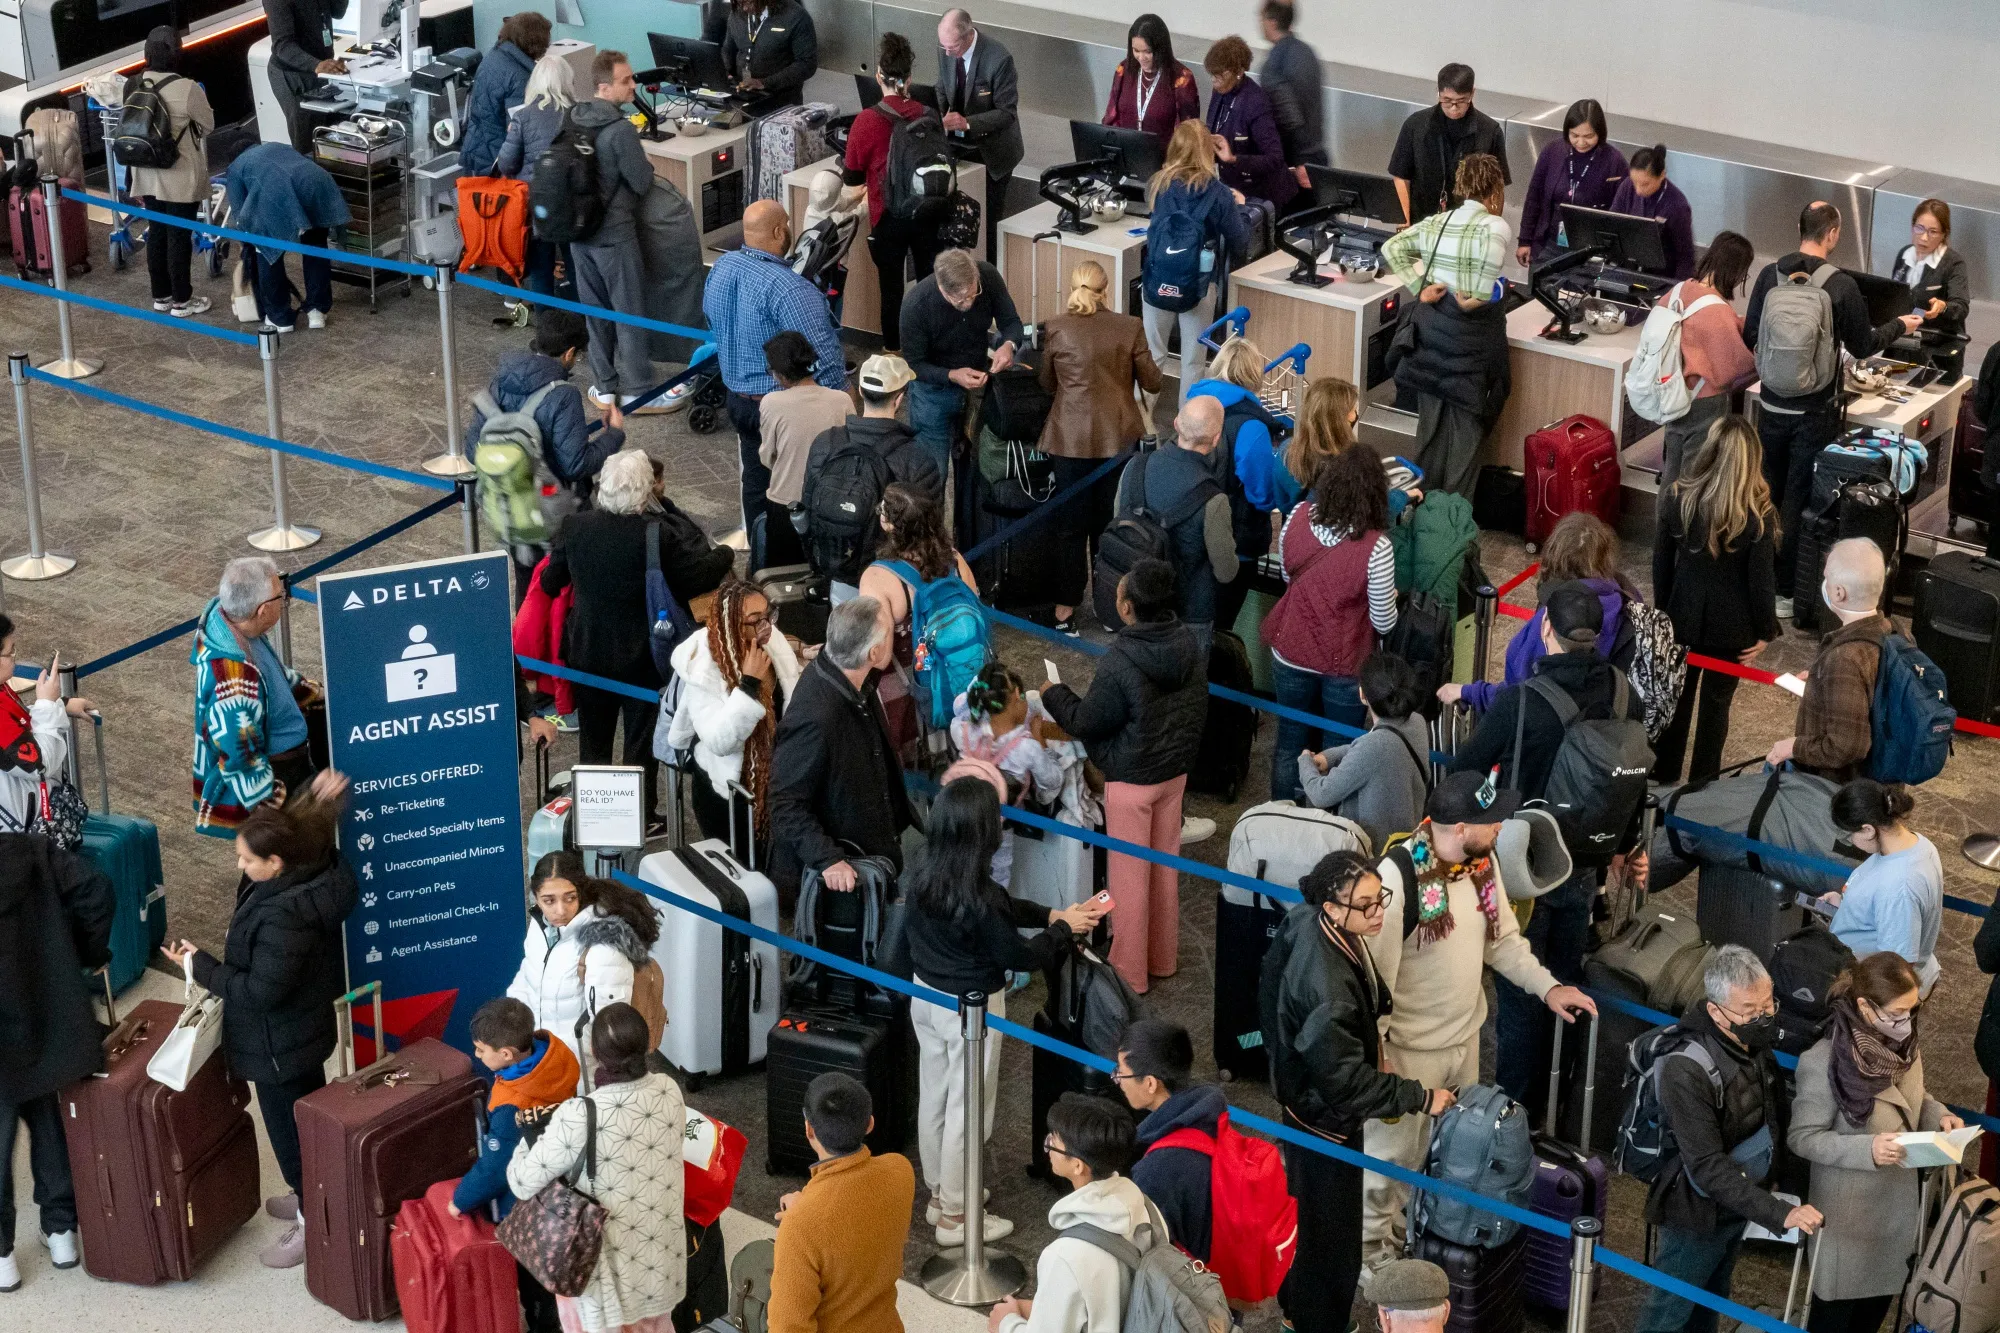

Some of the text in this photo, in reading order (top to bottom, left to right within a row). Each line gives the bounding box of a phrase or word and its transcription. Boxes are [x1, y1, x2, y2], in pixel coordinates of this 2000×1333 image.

[372, 576, 463, 605] DELTA
[349, 703, 500, 744] AGENT ASSIST
[354, 763, 484, 794] SERVICES OFFERED:
[1621, 767, 1647, 776] HOLCIM
[381, 797, 446, 815] Re-Ticketing
[580, 789, 593, 797] DO
[595, 789, 612, 797] YOU
[382, 815, 506, 844] Checked Specialty Items
[384, 844, 505, 872] Unaccompanied Minors
[386, 880, 456, 901] Carry-on Pets
[389, 902, 499, 929] International Check-In
[391, 934, 478, 958] Agent Assistance
